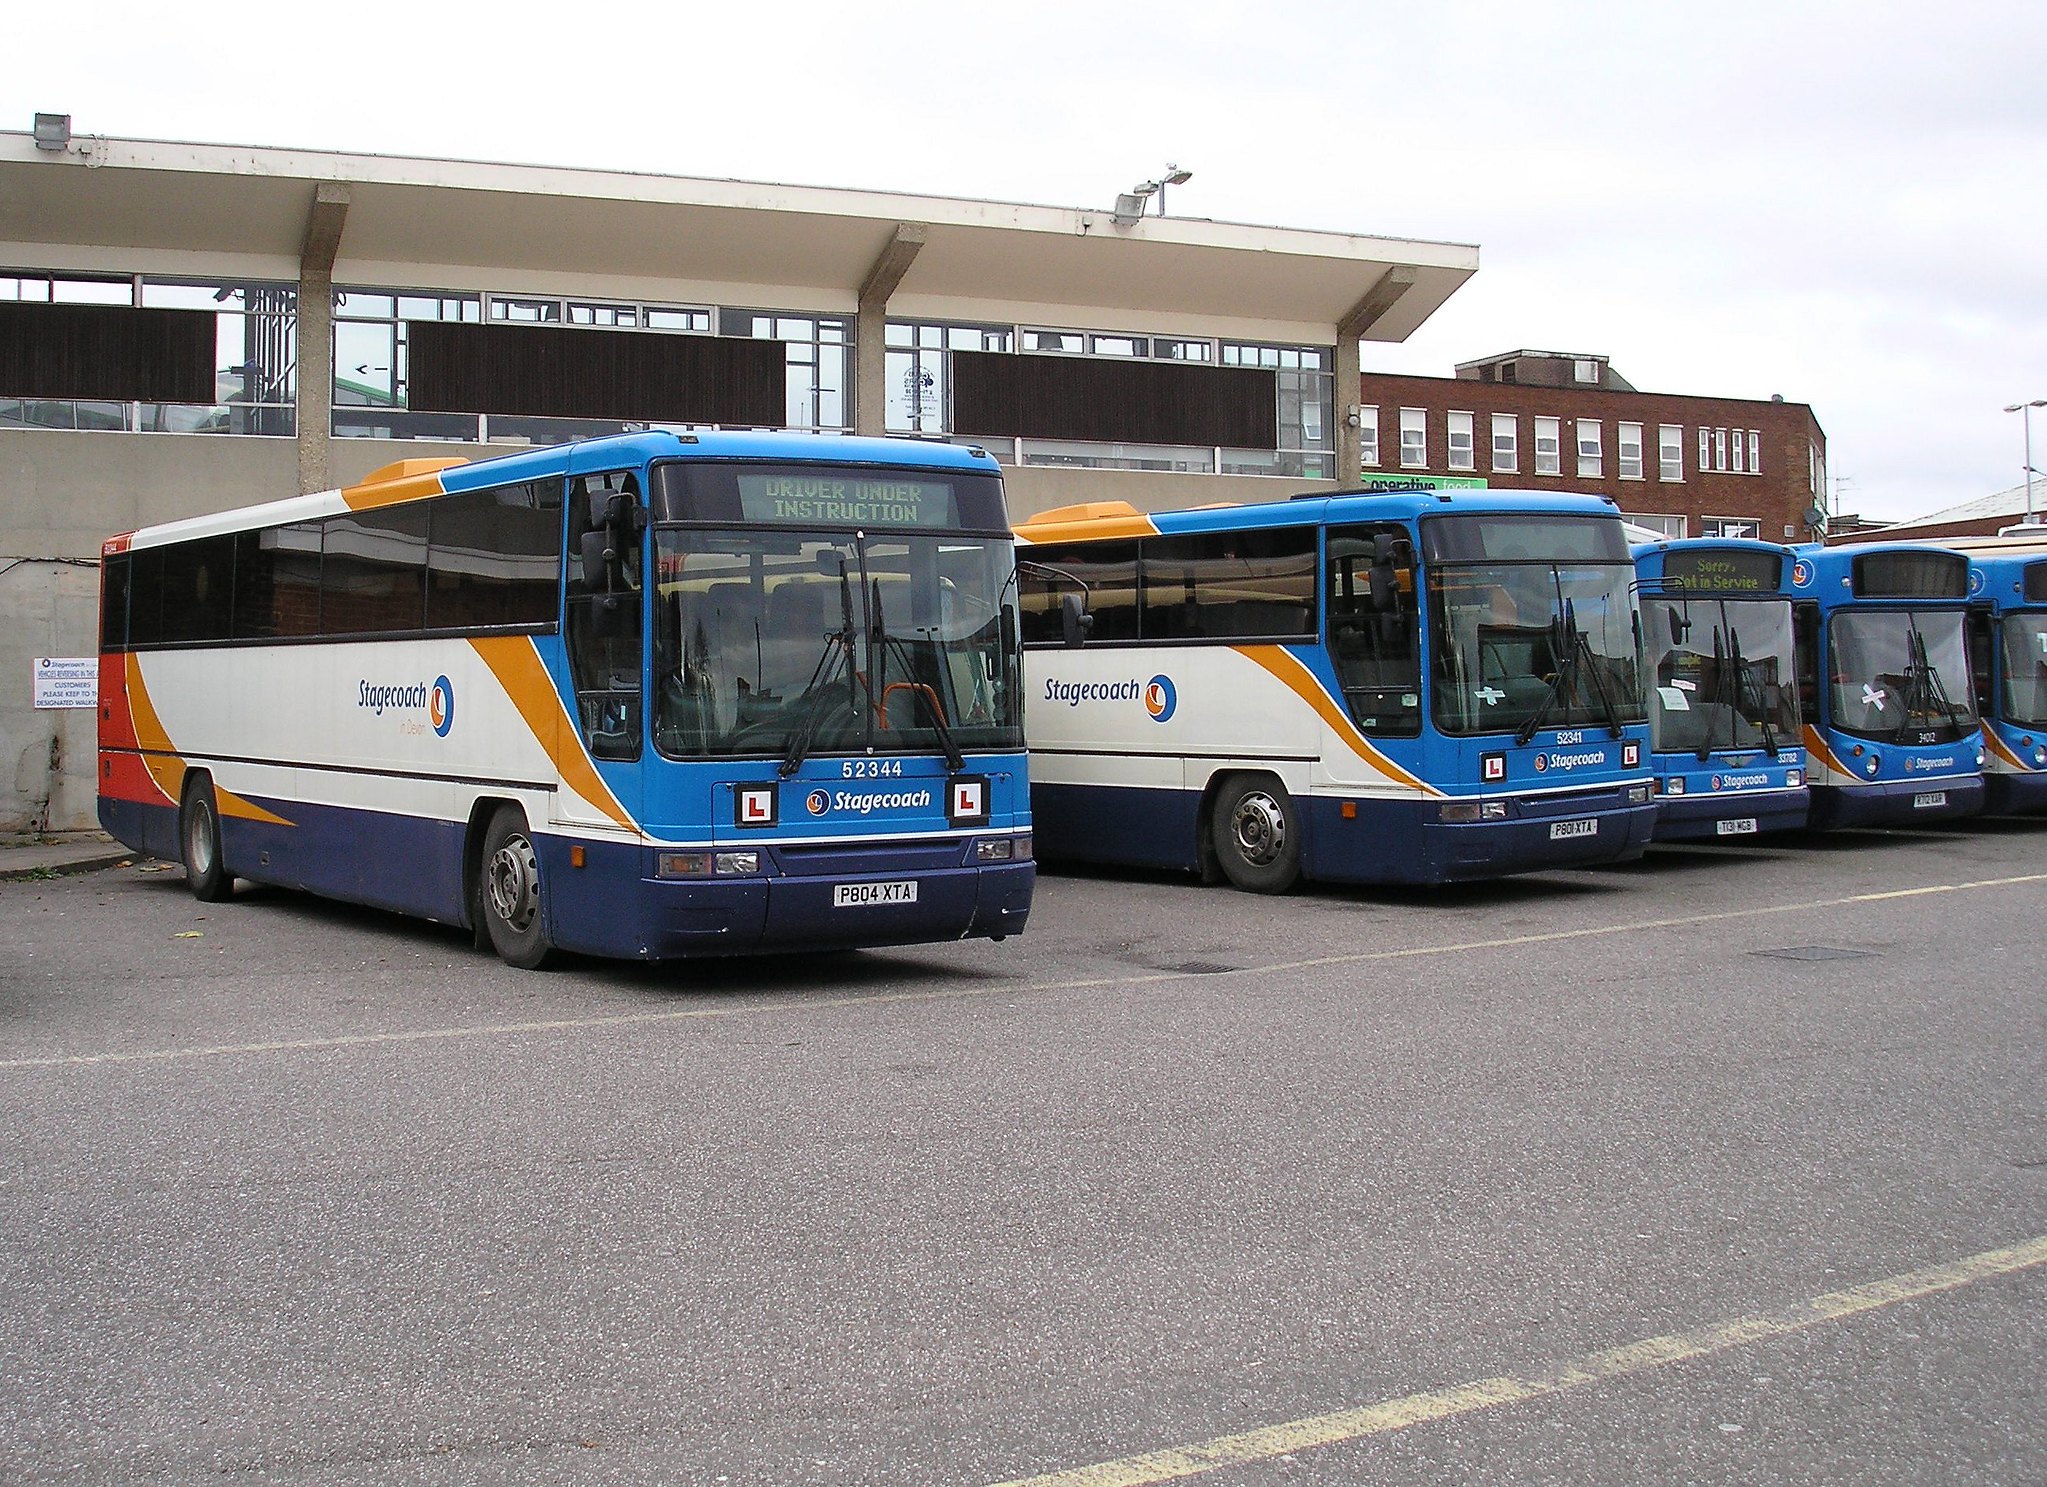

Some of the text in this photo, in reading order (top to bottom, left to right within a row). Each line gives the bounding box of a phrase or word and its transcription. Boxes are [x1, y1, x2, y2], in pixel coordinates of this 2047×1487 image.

[766, 479, 922, 502] DRIVER UNDER
[775, 500, 917, 522] INSTRUCTION
[1700, 574, 1710, 589] in
[1713, 575, 1758, 589] Service
[358, 679, 427, 716] Stagecoach
[1044, 678, 1140, 707] Stagecoach
[1556, 731, 1582, 745] 52341
[1550, 751, 1604, 770] Stagecoach
[1626, 748, 1635, 762] L
[1915, 756, 1953, 771] Stagecoach
[842, 761, 902, 778] 52344
[1490, 760, 1500, 775] L
[1723, 774, 1768, 789] Stagecoach
[749, 797, 765, 817] L
[833, 789, 931, 815] Stagecoach
[960, 790, 974, 810] L
[840, 883, 912, 904] P804 XTA
